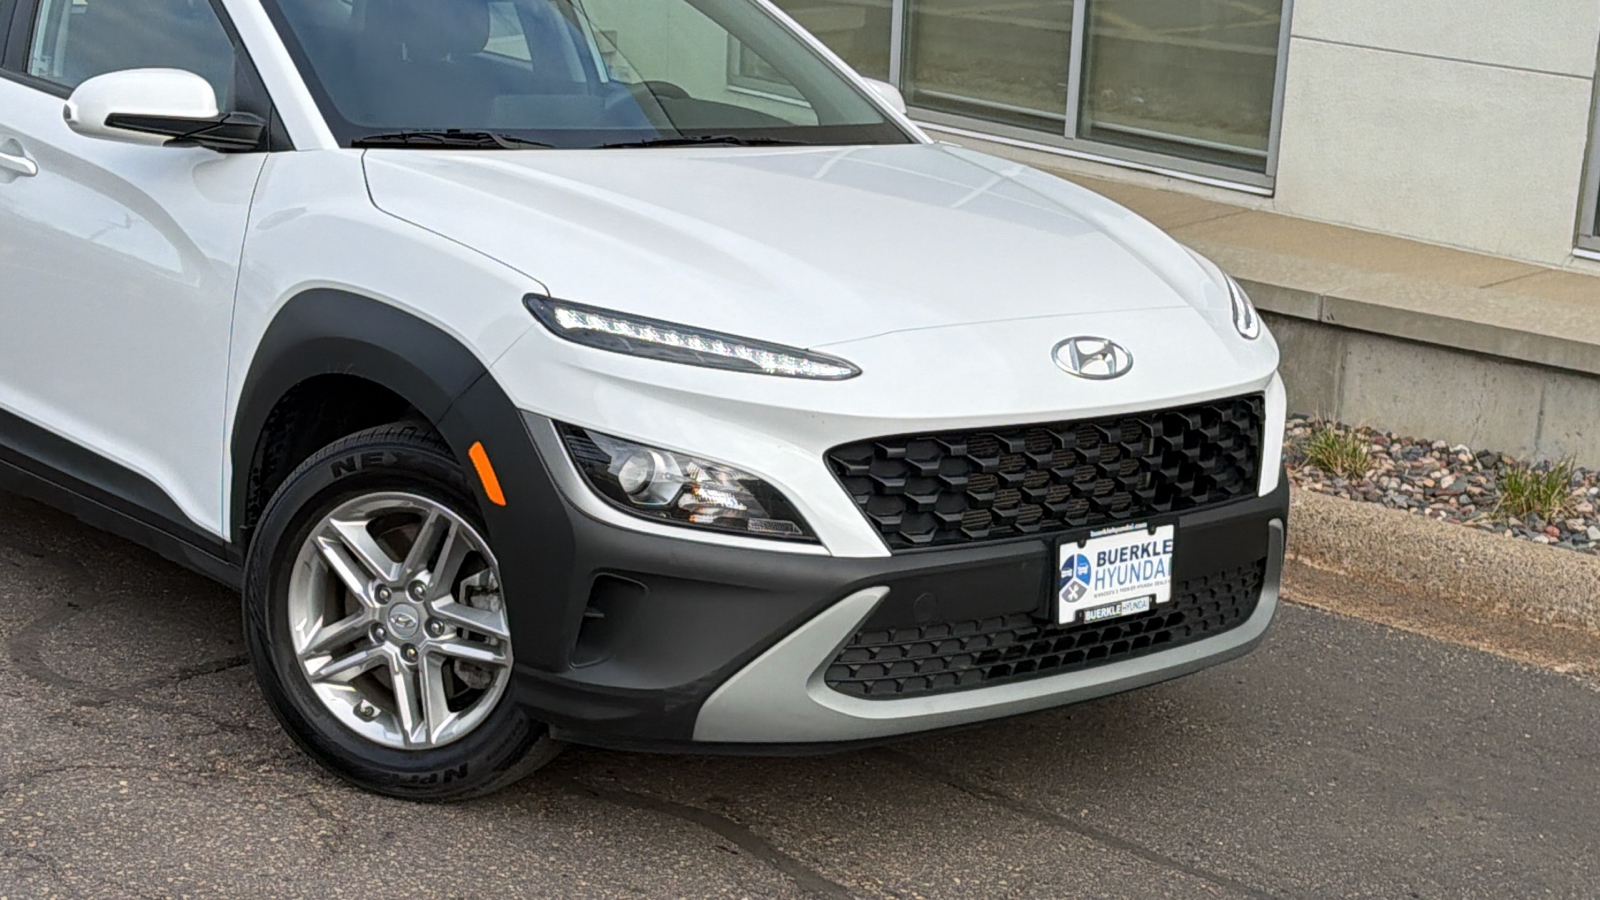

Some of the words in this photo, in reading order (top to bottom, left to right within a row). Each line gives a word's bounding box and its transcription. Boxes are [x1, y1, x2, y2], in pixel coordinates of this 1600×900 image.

[1096, 539, 1173, 567] BUERKLE
[1094, 555, 1172, 591] HYUNDAI
[1085, 604, 1121, 621] BUERKLE
[1122, 599, 1148, 614] HYUNDA
